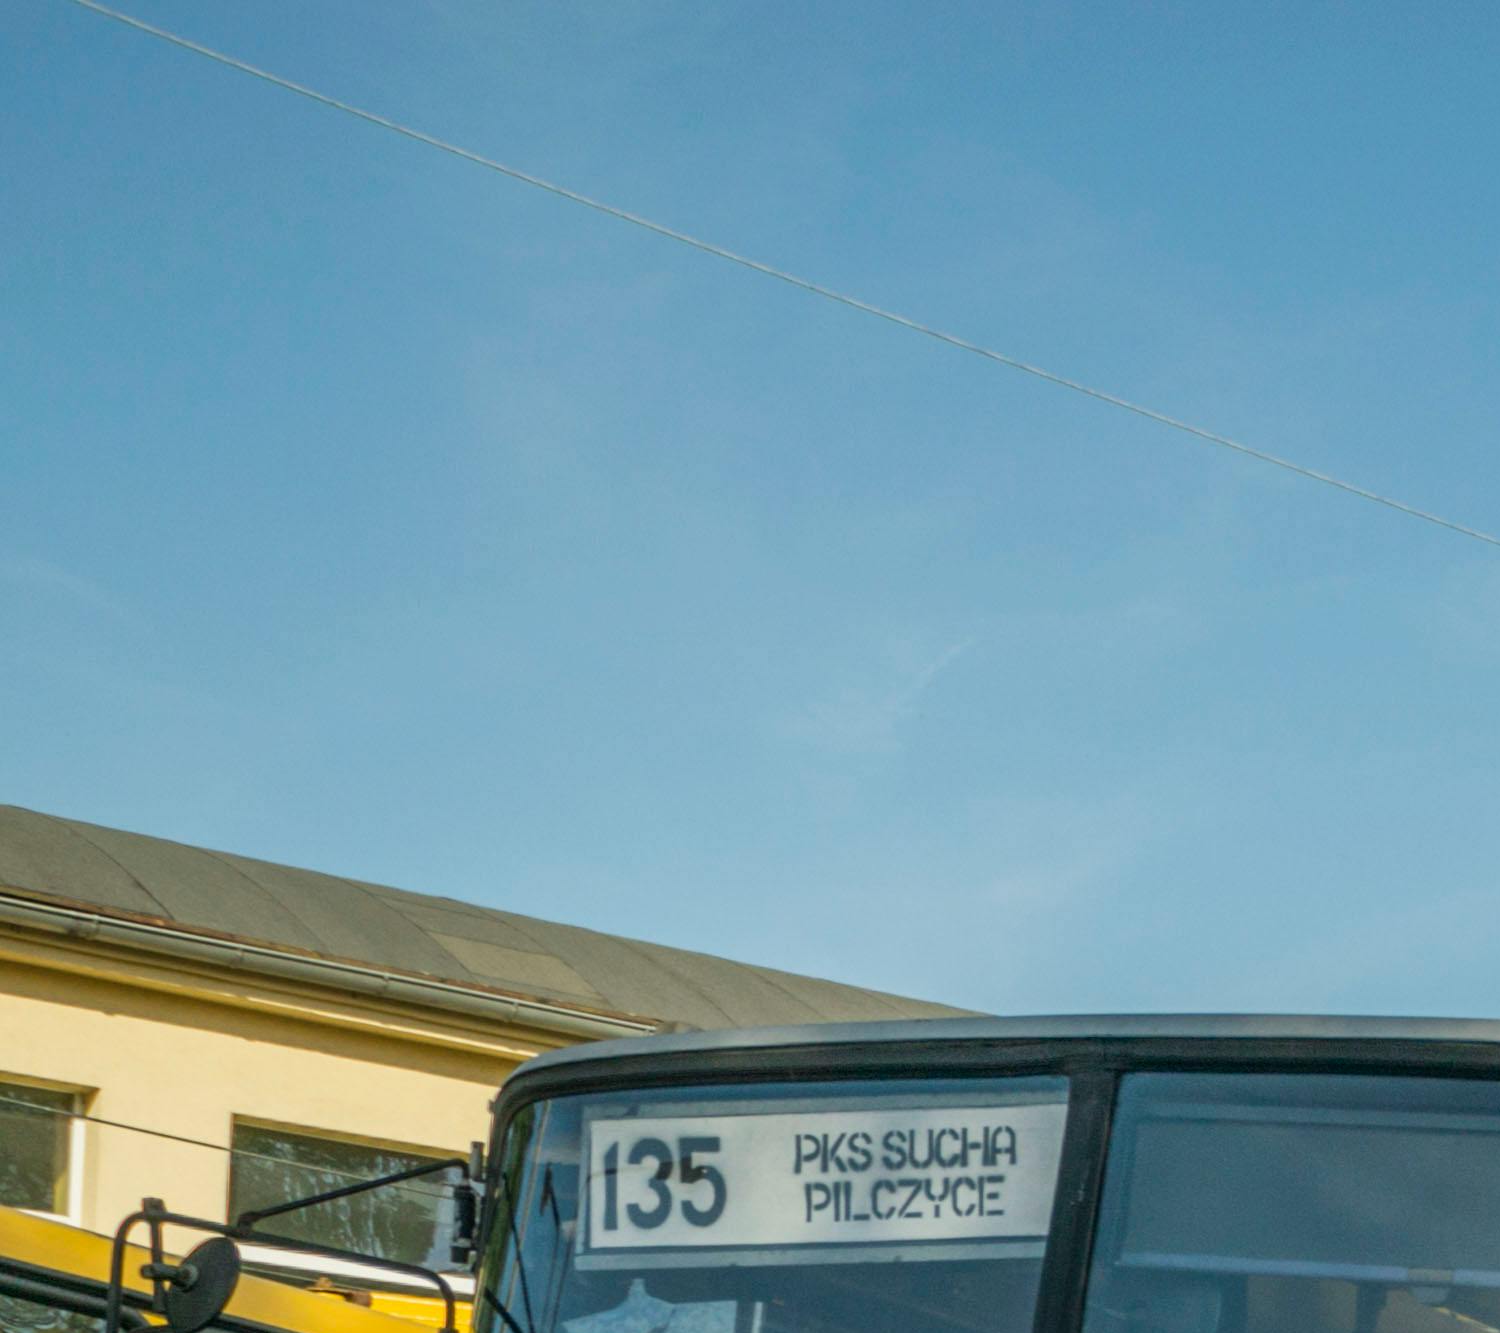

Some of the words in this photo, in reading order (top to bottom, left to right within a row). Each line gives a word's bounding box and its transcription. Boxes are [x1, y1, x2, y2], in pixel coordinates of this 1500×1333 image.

[792, 1130, 873, 1175] PKS
[882, 1124, 1018, 1170] SUCHA
[602, 1135, 728, 1232] 135
[804, 1174, 1007, 1223] PILCZYCE
